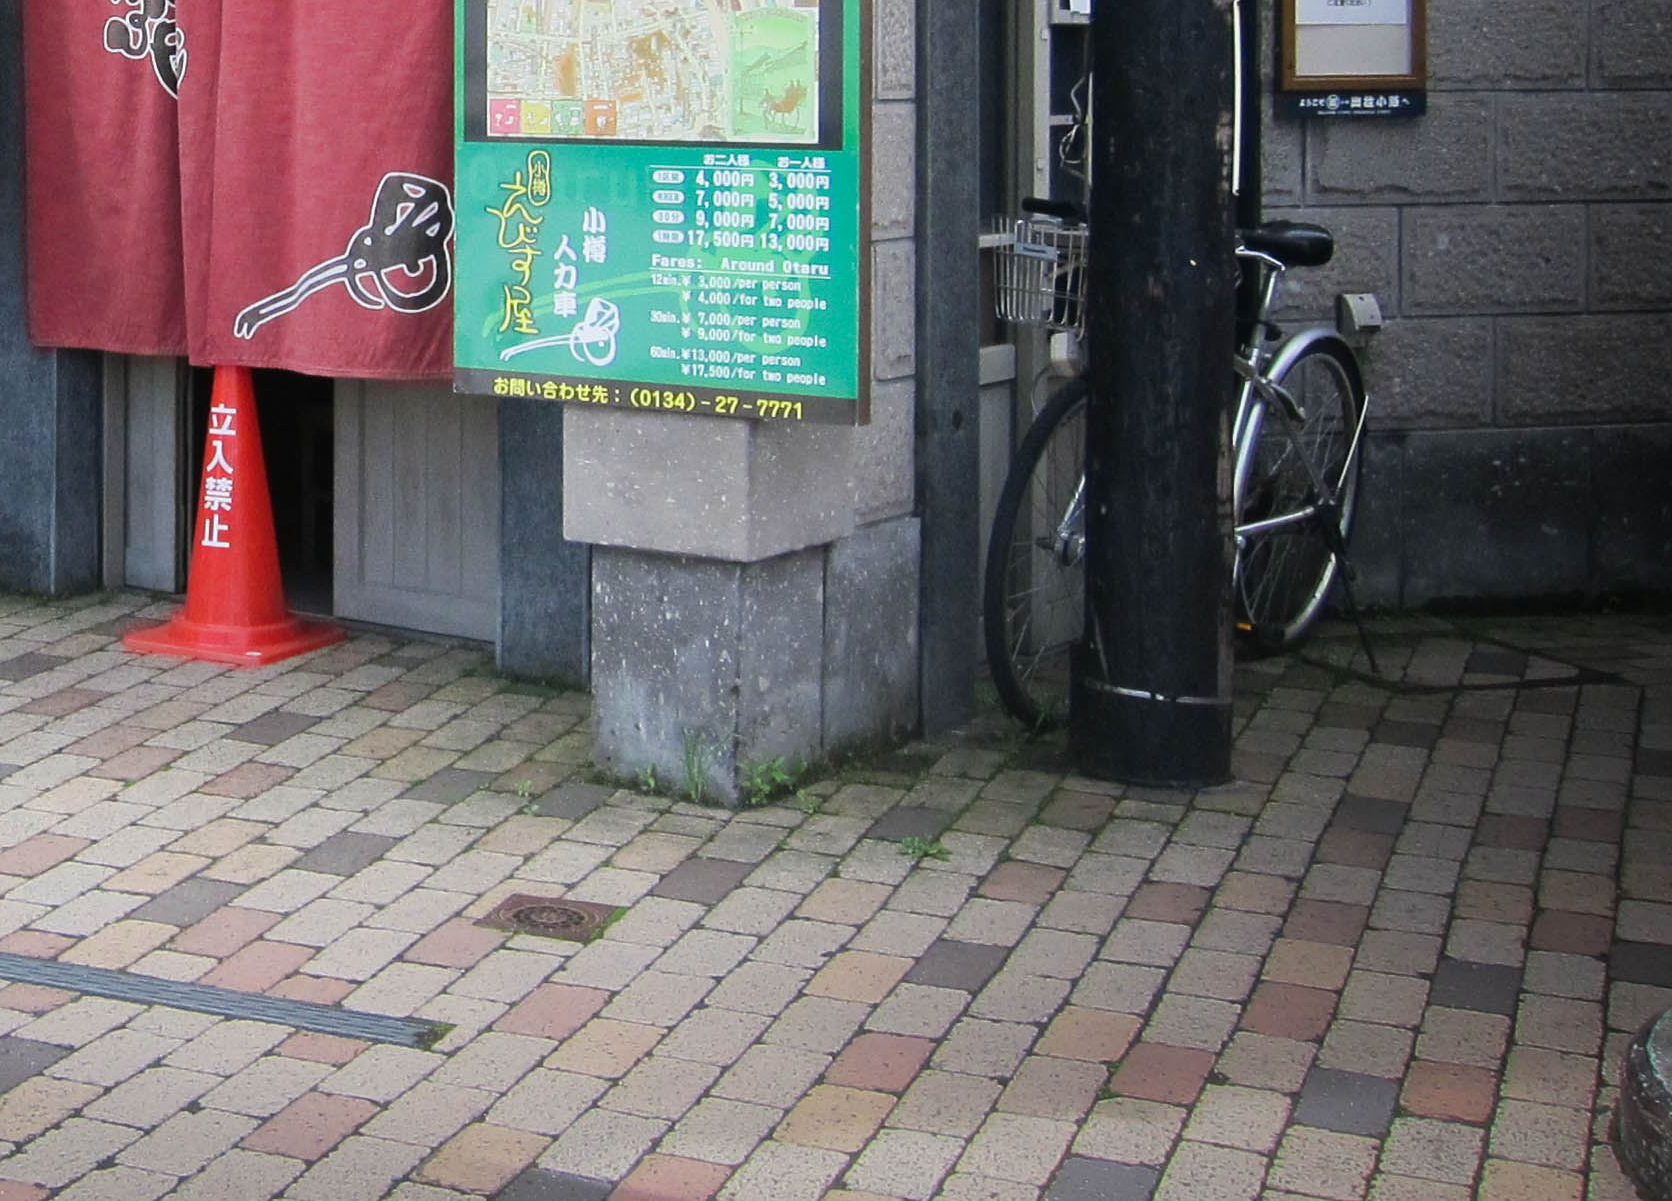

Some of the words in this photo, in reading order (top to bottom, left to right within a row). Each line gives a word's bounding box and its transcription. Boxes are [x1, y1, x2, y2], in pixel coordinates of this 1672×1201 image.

[703, 154, 750, 166] お二人様
[777, 156, 825, 169] お一人様
[532, 161, 547, 196] 小樽
[696, 170, 754, 187] 4,000円
[768, 172, 830, 190] 3,000円
[696, 190, 754, 208] 7,000円
[768, 193, 830, 211] 5,000円
[696, 210, 754, 228] 9,000円
[768, 213, 830, 232] 7,000円
[582, 207, 607, 263] 小樽
[688, 230, 754, 248] 17,500円
[760, 233, 830, 252] 13,000円
[486, 171, 543, 334] えびす屋
[651, 254, 702, 269] Fares:
[721, 257, 775, 272] Around
[782, 260, 829, 275] Otaru
[553, 234, 577, 318] 人力車
[762, 279, 801, 292] person
[763, 296, 782, 307] two
[787, 297, 827, 311] people
[762, 316, 801, 329] person
[763, 333, 781, 345] two
[787, 335, 827, 348] people
[762, 354, 801, 367] person
[762, 370, 782, 381] two
[786, 372, 826, 386] people
[201, 403, 237, 548] 立入禁止
